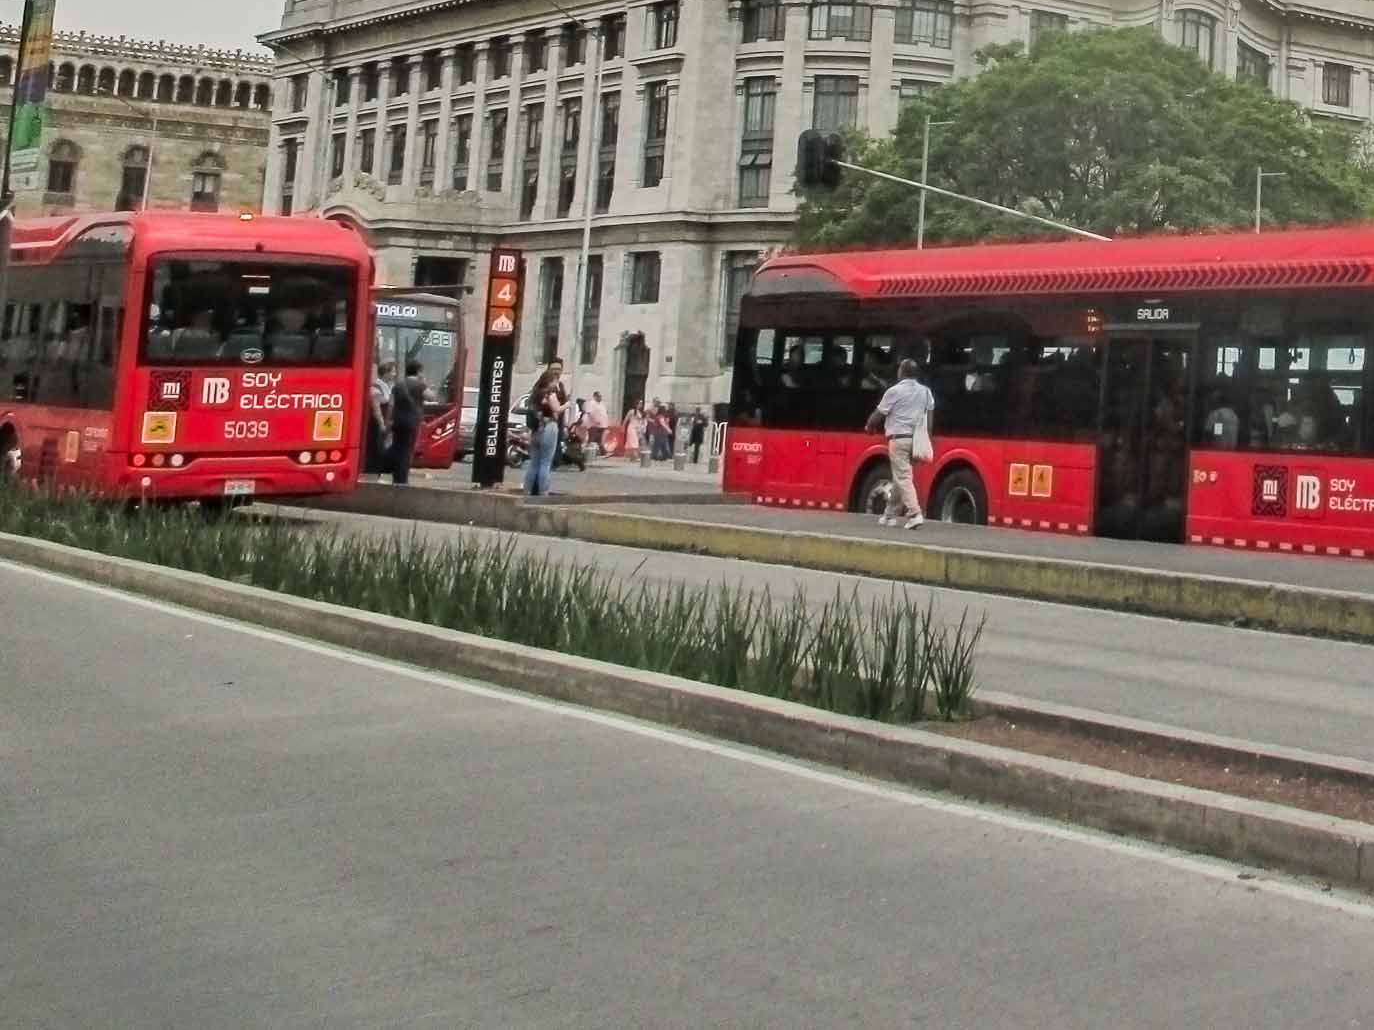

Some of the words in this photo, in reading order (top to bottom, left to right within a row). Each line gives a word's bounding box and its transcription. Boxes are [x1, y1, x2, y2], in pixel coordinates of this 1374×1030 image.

[497, 284, 512, 301] 4
[1137, 308, 1169, 320] SALIDA
[242, 372, 282, 388] SOY
[491, 360, 504, 403] ARTES
[240, 391, 343, 409] ELÉCTRICO
[224, 420, 269, 439] 5039
[486, 405, 500, 456] BELLAS
[1330, 478, 1356, 492] SOY
